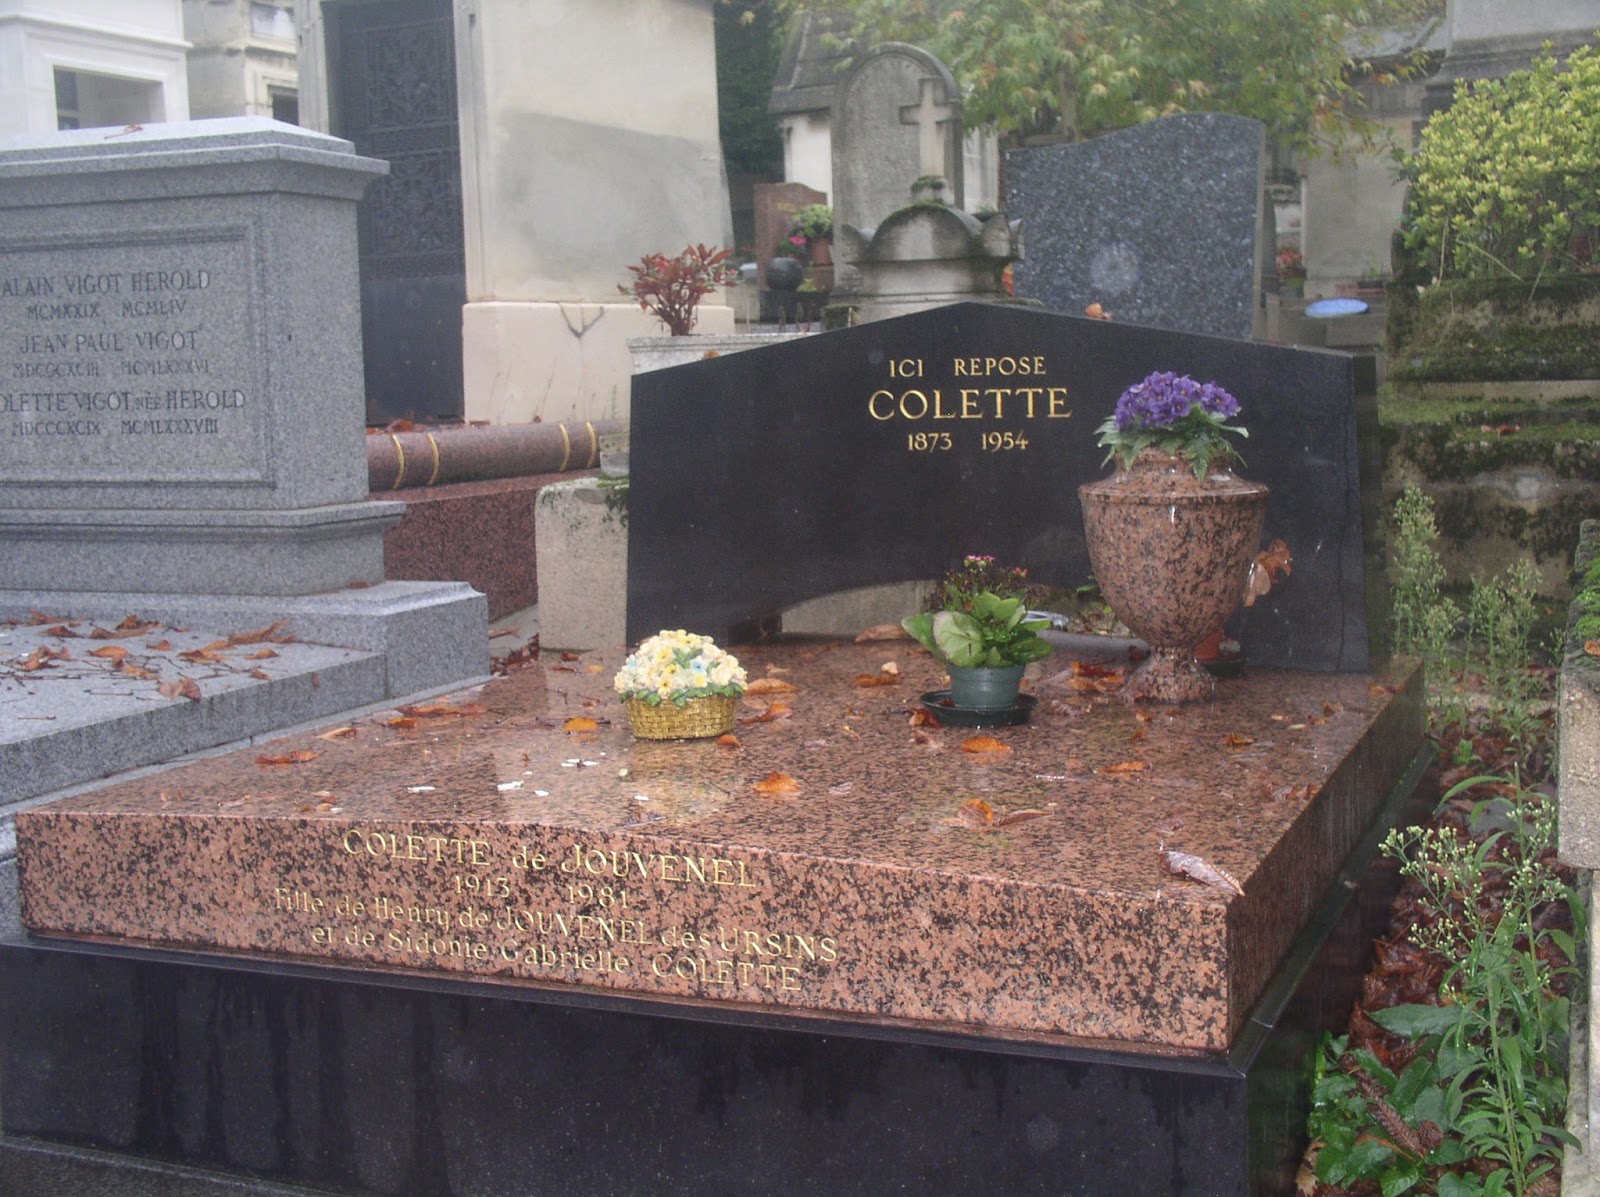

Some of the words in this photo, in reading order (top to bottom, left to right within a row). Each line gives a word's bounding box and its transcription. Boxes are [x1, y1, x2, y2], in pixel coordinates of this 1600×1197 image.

[2, 277, 55, 297] ALAIN
[64, 273, 122, 295] VIGOT
[131, 270, 210, 292] HEROLD
[121, 299, 187, 316] MCMLIV
[20, 334, 67, 354] JEAN
[75, 333, 123, 352] PAUL
[135, 330, 198, 350] VIGOT
[889, 359, 923, 377] ICI
[953, 356, 1047, 376] REPOSE
[69, 391, 130, 411] VIGOT
[166, 390, 246, 409] HEROLD
[868, 387, 1073, 420] COLETTE
[908, 432, 953, 453] 1873
[982, 430, 1029, 452] 1954
[343, 829, 491, 867] COLETTE
[512, 845, 546, 870] de
[560, 844, 756, 888] JOUVENEL
[455, 874, 510, 898] 1913
[568, 884, 628, 909] 1981
[275, 887, 323, 912] Fille
[336, 895, 365, 916] de
[374, 897, 449, 933] Henry
[459, 906, 488, 928] de
[497, 906, 652, 945] JOUVENEL
[661, 926, 711, 950] des
[719, 926, 838, 962] URSINS
[345, 925, 375, 947] de
[388, 928, 487, 960] Sidonie
[501, 939, 630, 974] Gabrielle
[651, 953, 802, 991] COLETTE
